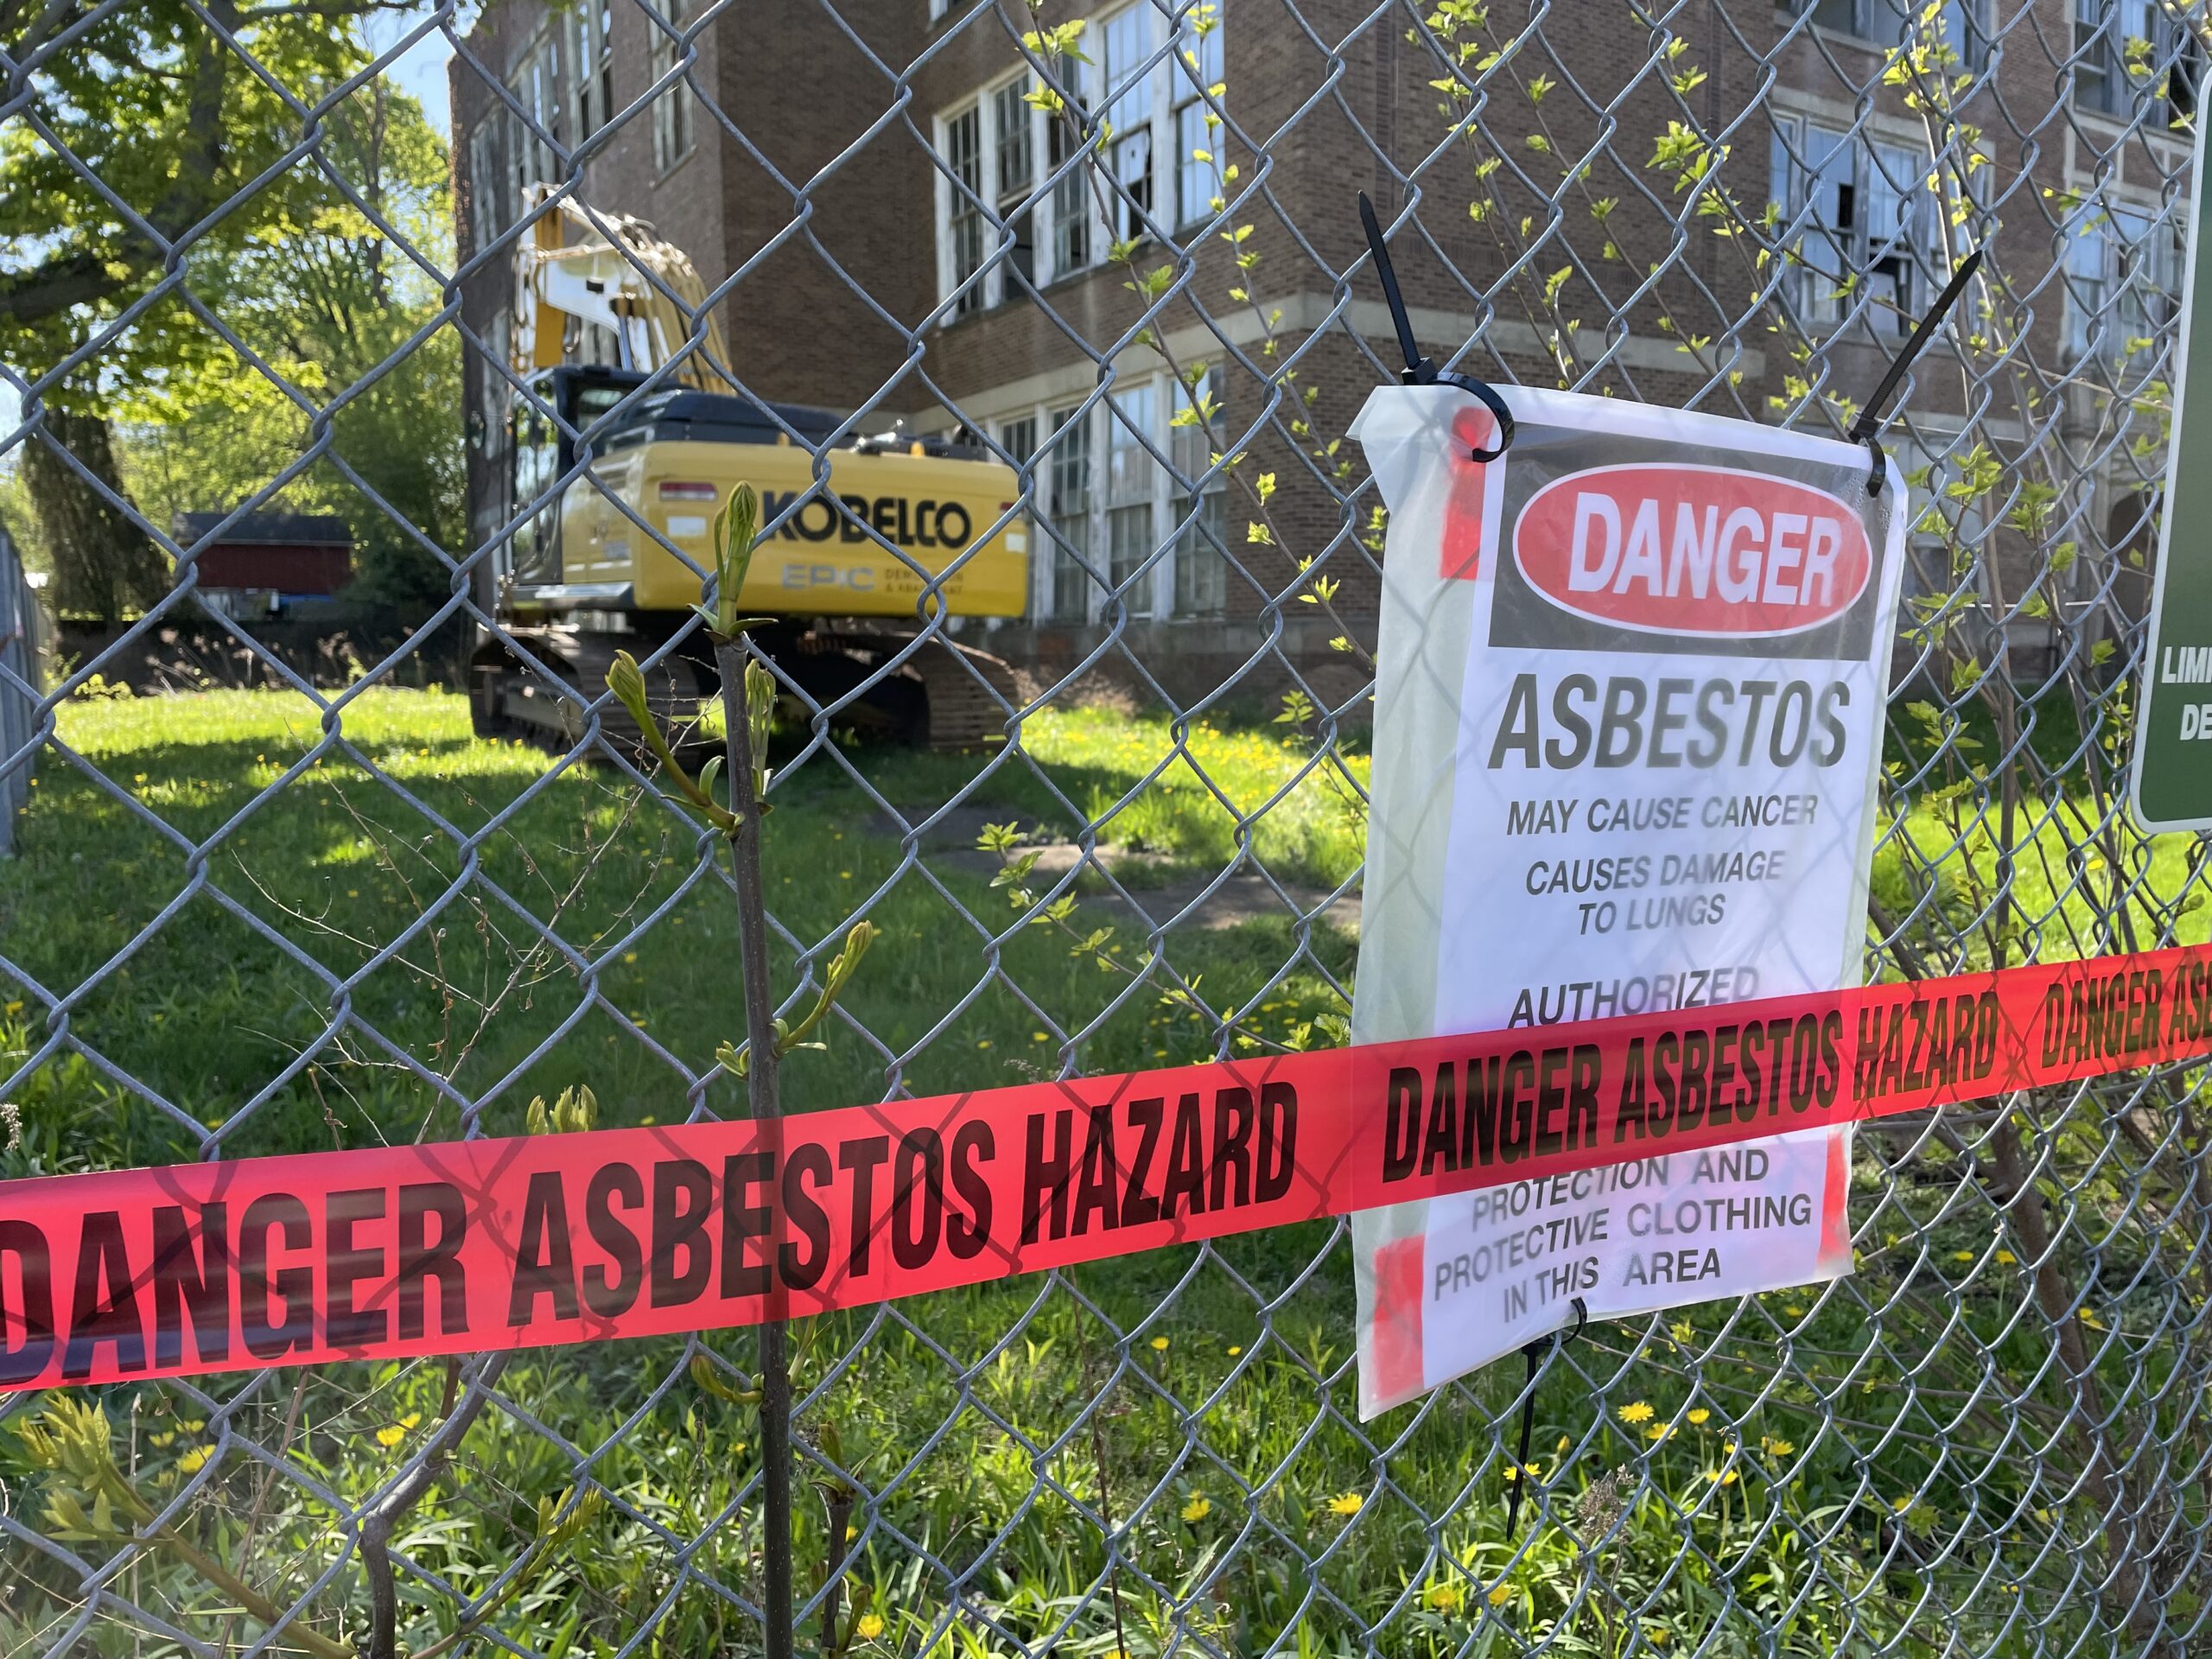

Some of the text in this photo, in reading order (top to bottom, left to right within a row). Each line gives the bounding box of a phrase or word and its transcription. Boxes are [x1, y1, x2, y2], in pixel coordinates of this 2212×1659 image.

[763, 491, 972, 549] KOBELCO
[1567, 492, 1842, 607] DANGER
[1487, 673, 1851, 770] ASBESTOS
[2179, 703, 2212, 741] DE
[1506, 793, 1818, 836] MAY CAUSE CANCER
[1525, 850, 1787, 896] CAUSES DAMAGE
[1577, 893, 1726, 935] TO LUNGS
[1507, 966, 1760, 1029] AUTHORIZED
[0, 1181, 468, 1384] DANGER
[507, 1119, 996, 1328] ASBESTOS
[1019, 1081, 1299, 1246] HAZARD
[1382, 1044, 1602, 1184] DANGER
[1612, 1009, 1843, 1144] ASBESTOS
[1853, 991, 2000, 1102] HAZARD
[2042, 969, 2163, 1069] DANGER
[1471, 1148, 1770, 1232] PROTECTION AND
[1434, 1192, 1812, 1301] PROTECTIVE CLOTHING
[1503, 1247, 1722, 1323] IN THIS AREA
